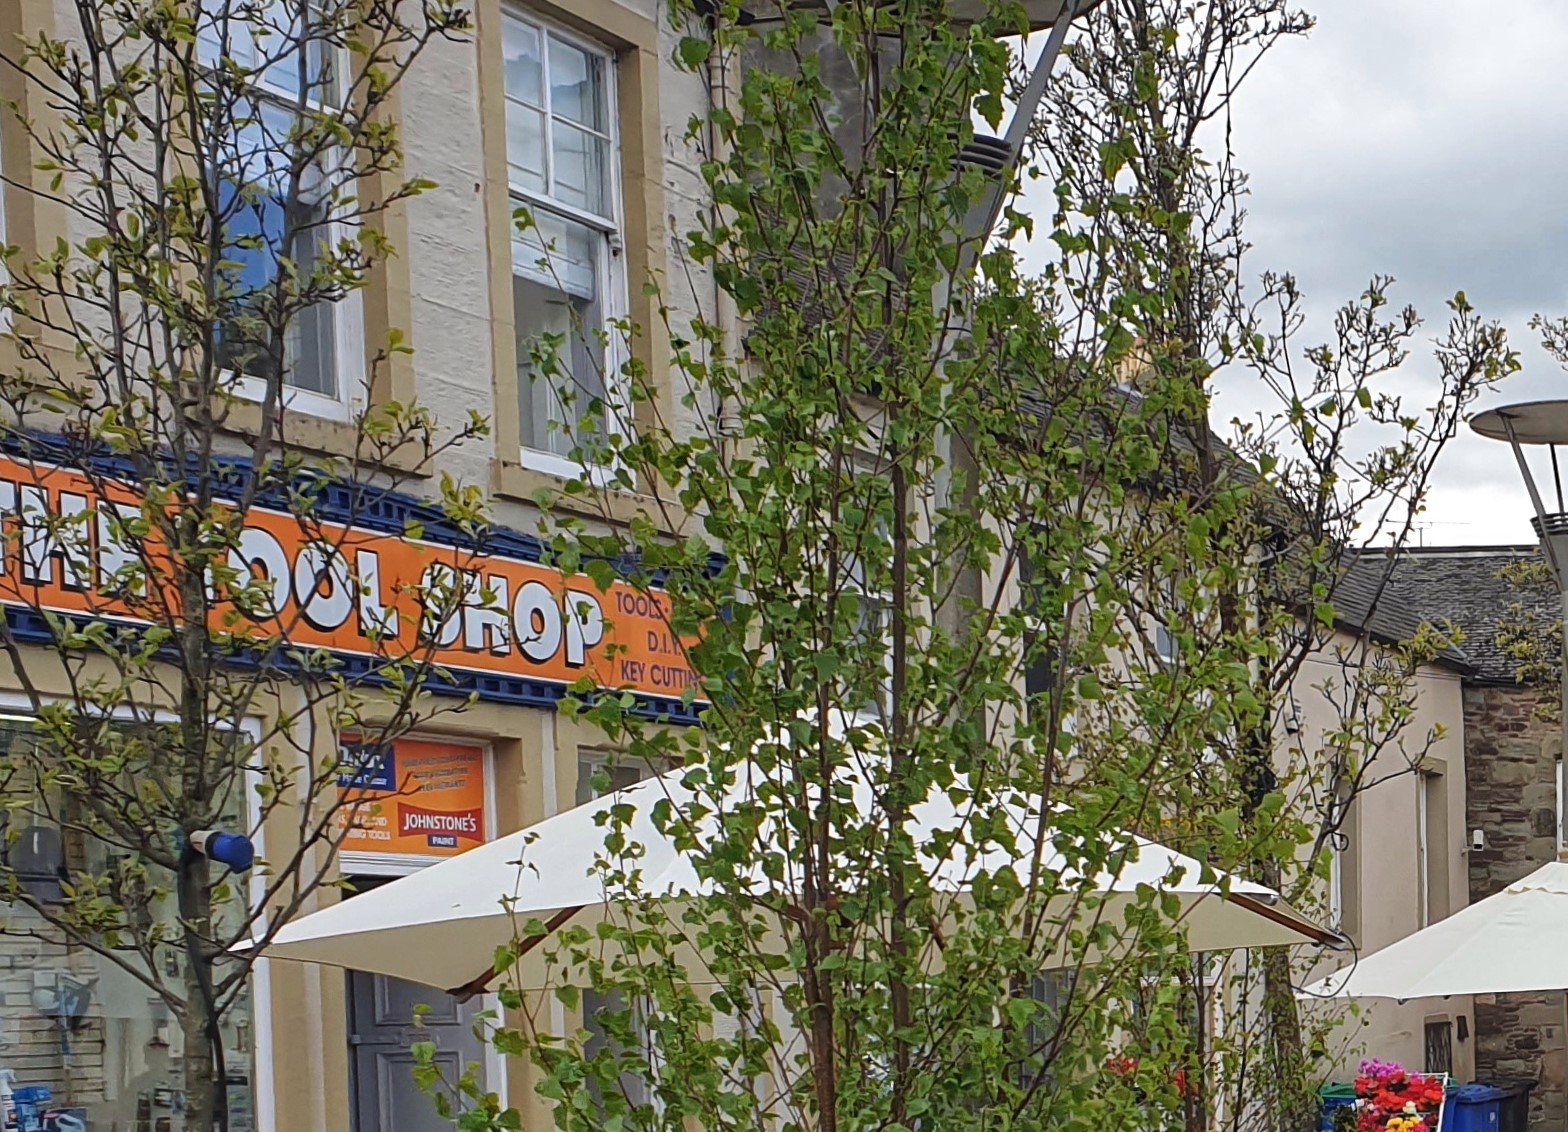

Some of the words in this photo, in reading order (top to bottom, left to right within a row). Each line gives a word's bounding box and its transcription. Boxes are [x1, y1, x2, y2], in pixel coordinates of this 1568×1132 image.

[172, 513, 400, 638] OOL
[421, 562, 604, 667] SHOP
[615, 590, 664, 619] TOOLS
[621, 659, 646, 682] KEY
[651, 664, 700, 692] CUTTIN
[403, 813, 477, 833] JOHNSTONE'S
[431, 835, 455, 846] PAINT
